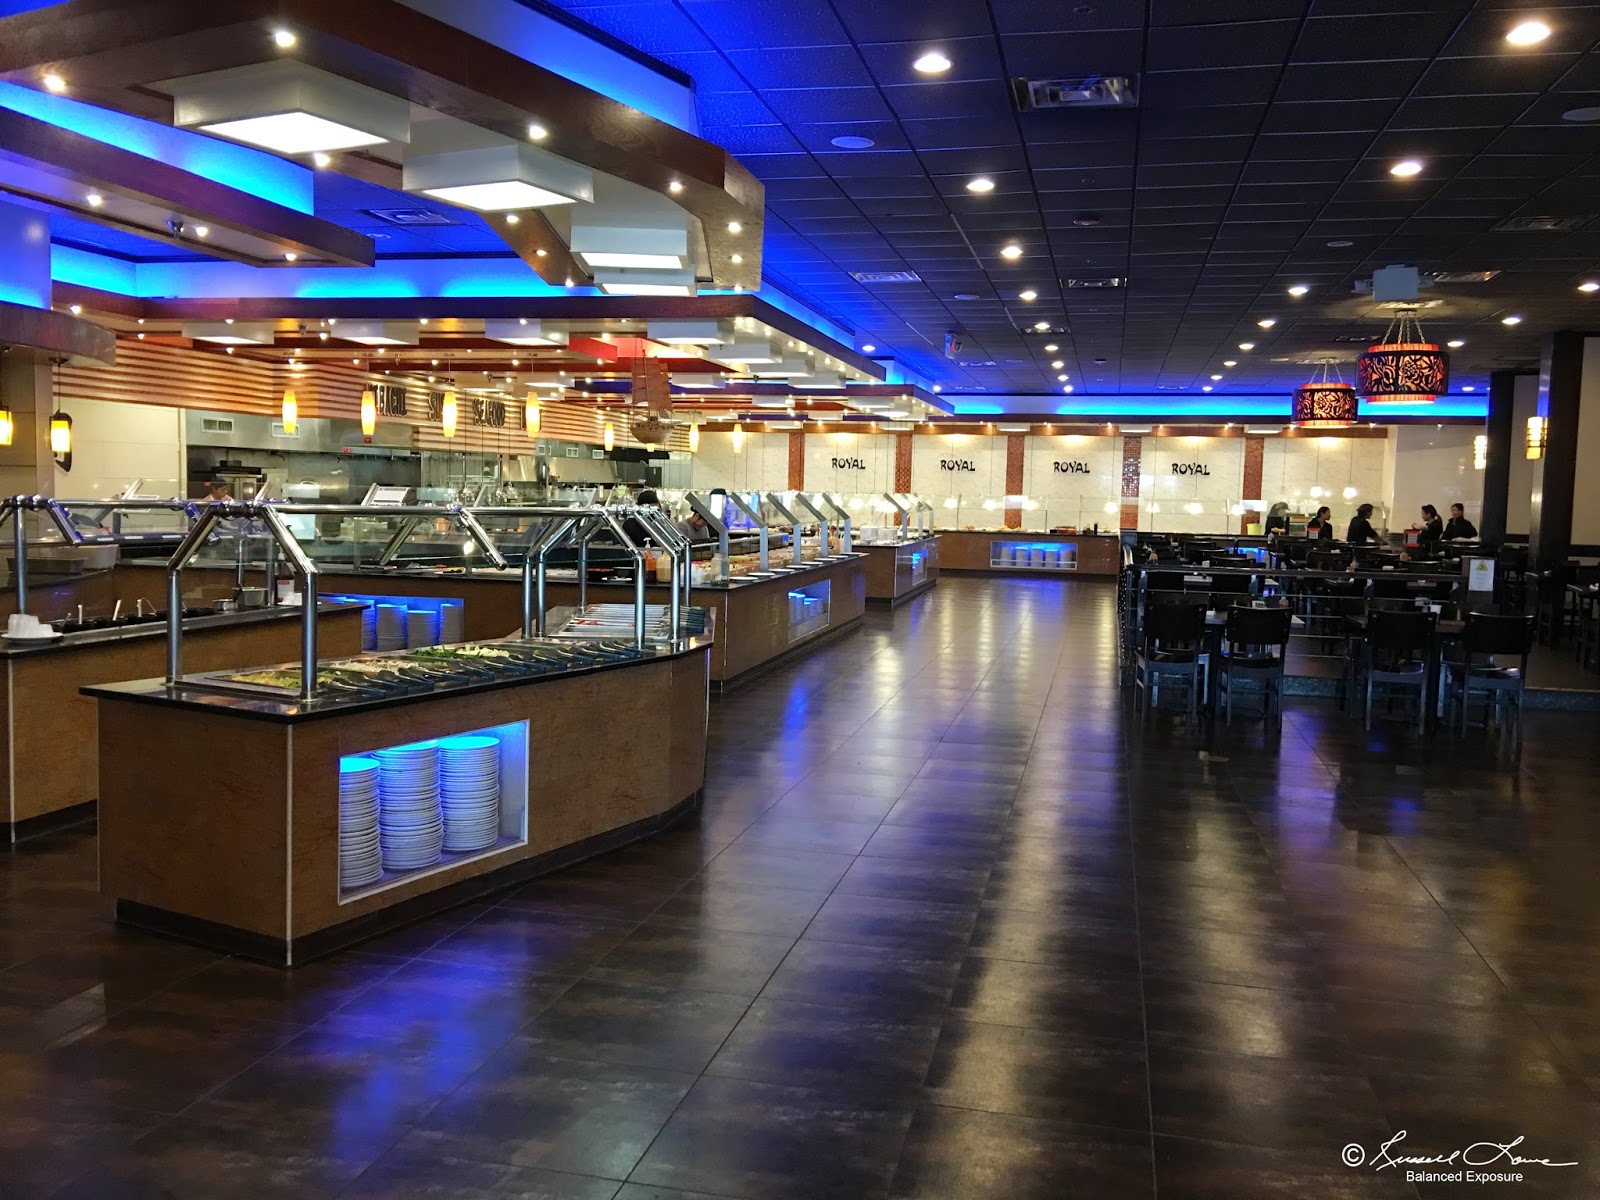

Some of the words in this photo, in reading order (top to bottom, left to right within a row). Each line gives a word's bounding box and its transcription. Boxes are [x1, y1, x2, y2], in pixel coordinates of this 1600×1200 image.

[367, 383, 408, 417] IBACHI
[831, 457, 866, 470] ROYAL
[940, 459, 976, 472] ROYAL
[1053, 460, 1091, 474] ROYAL
[1171, 462, 1211, 476] ROYAL
